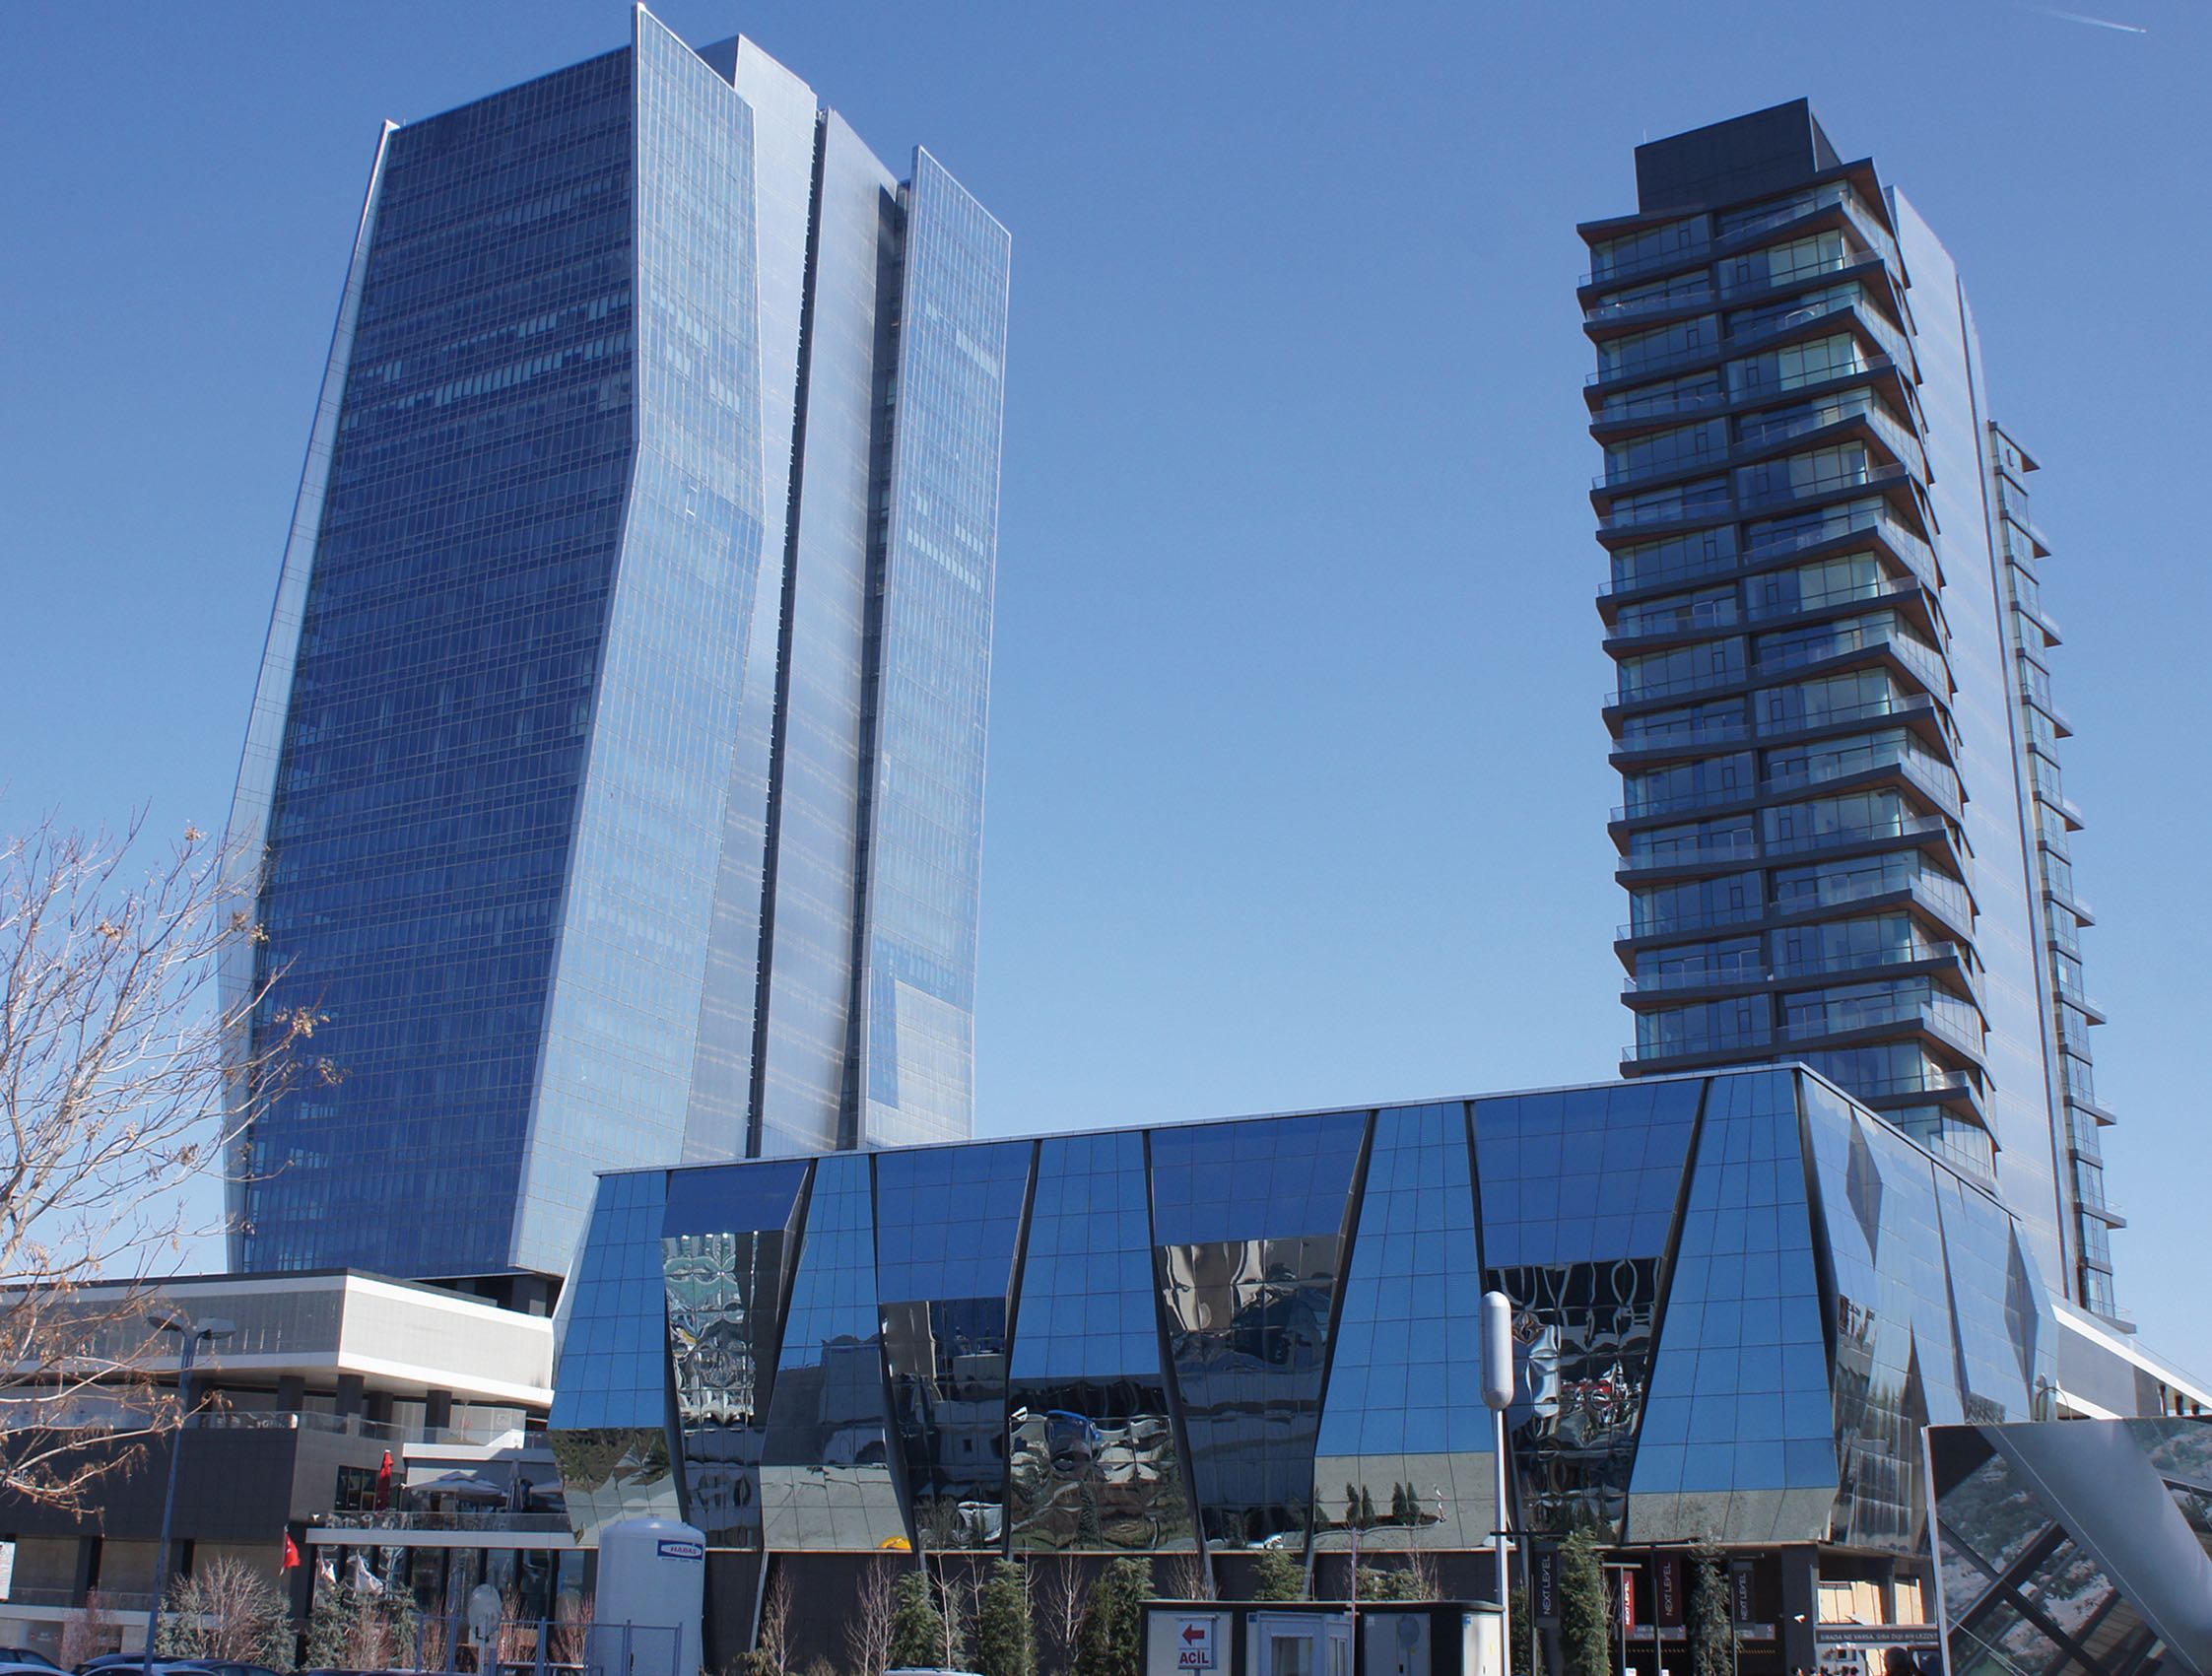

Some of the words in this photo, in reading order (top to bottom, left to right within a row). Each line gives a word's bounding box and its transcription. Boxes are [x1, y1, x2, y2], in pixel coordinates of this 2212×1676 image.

[1542, 1556, 1551, 1588] LEVEL
[1663, 1563, 1672, 1592] LEVEL
[1738, 1573, 1747, 1599] LEVEL
[1542, 1590, 1551, 1615] NEXT
[1664, 1593, 1673, 1616] NEXT
[1739, 1600, 1748, 1621] NEXT
